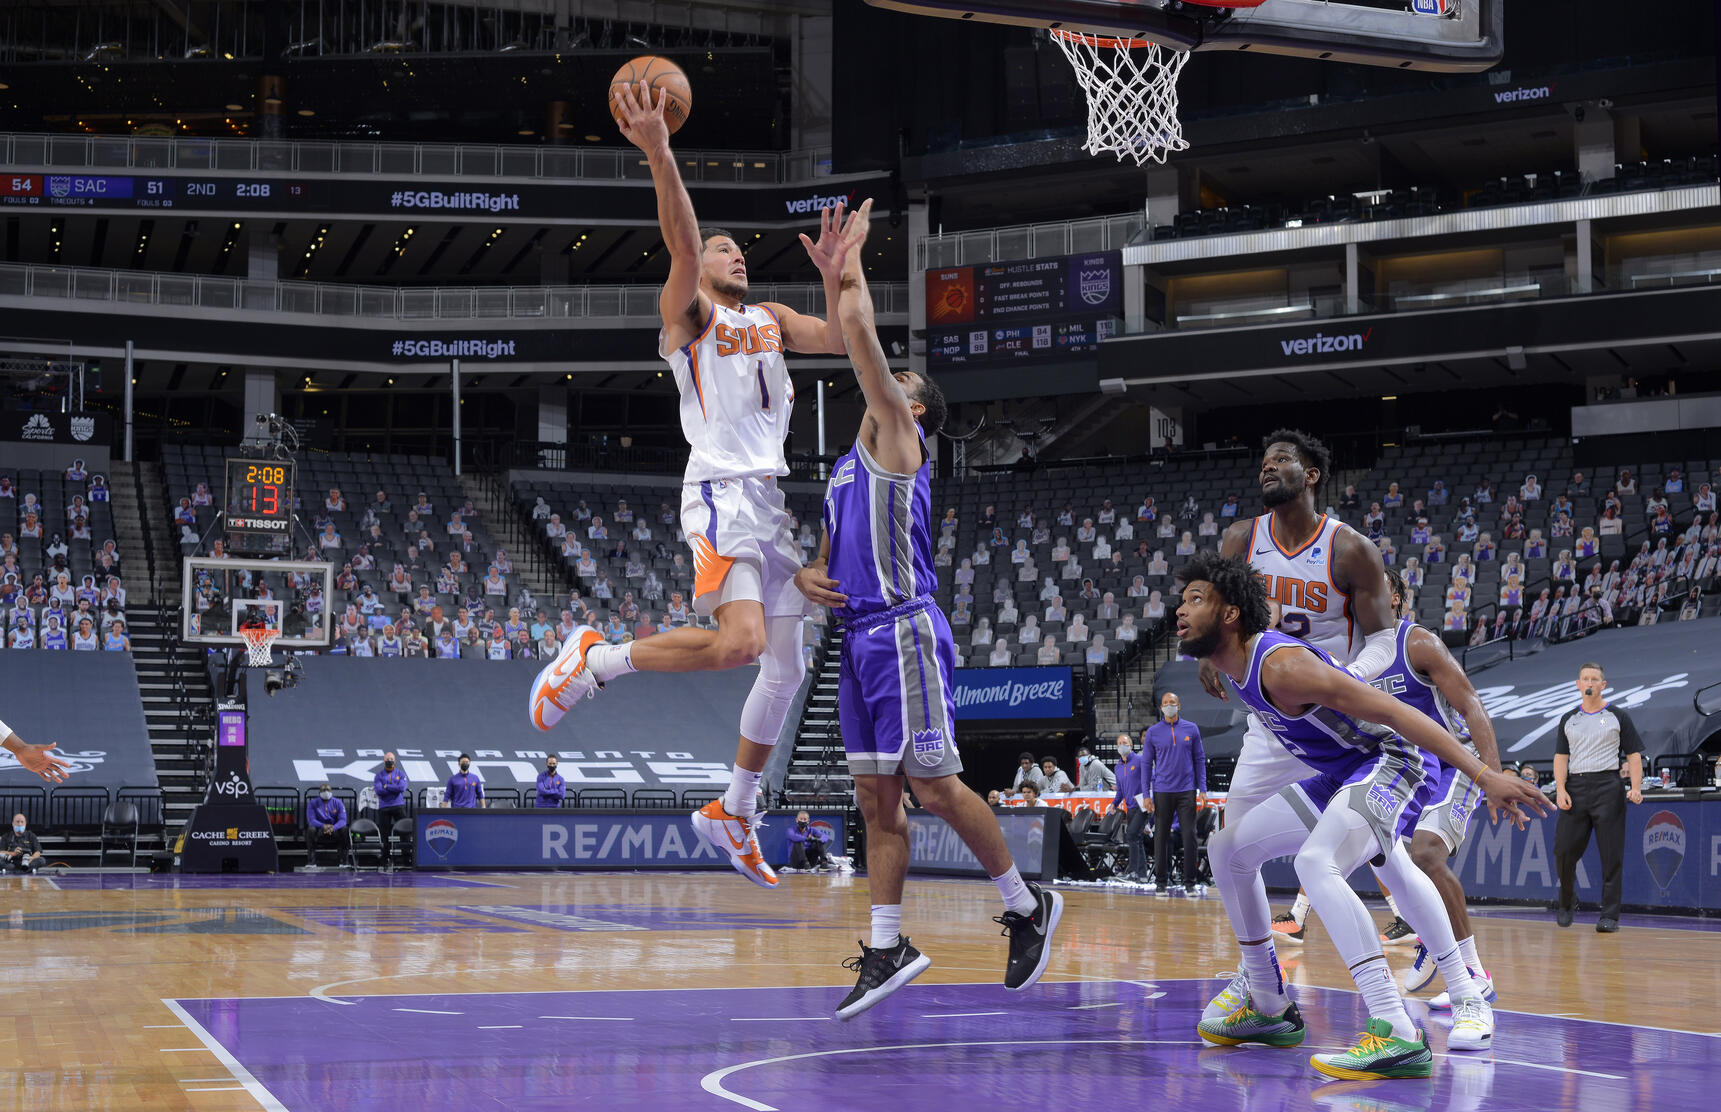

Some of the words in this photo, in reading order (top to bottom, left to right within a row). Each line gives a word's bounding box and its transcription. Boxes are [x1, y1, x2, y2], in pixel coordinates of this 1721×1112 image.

[1417, 0, 1434, 10] NBA
[1494, 86, 1550, 103] verizon
[12, 179, 32, 191] 54
[74, 180, 107, 192] SAC
[147, 181, 164, 194] 51
[187, 183, 216, 195] 2ND
[236, 184, 270, 197] 2:08
[291, 187, 301, 195] 13
[391, 191, 519, 212] #5GBuiltRight
[785, 194, 849, 214] verizon
[1008, 264, 1034, 274] HUSTLE
[1035, 262, 1059, 271] STATS
[1069, 324, 1083, 333] MIL
[943, 335, 959, 344] SAS
[1006, 331, 1020, 339] PHI
[1069, 335, 1086, 343] NYK
[392, 340, 516, 358] #5GBuiltRight
[943, 346, 961, 355] NOP
[1006, 340, 1022, 350] CLE
[1281, 333, 1363, 356] verizon
[757, 360, 770, 410] 1
[1157, 418, 1176, 438] 103
[247, 466, 284, 484] 2:08
[252, 485, 278, 514] 13
[245, 519, 288, 529] TISSOT
[953, 680, 1012, 708] Almond
[1009, 680, 1064, 707] Breeze
[218, 703, 245, 711] SPALDING
[914, 740, 944, 753] SAC
[315, 748, 694, 760] SACRAMENTO
[293, 759, 736, 784] KINGS
[1368, 790, 1393, 816] SAC
[191, 831, 225, 840] CACHE
[238, 831, 270, 839] CREEK
[429, 828, 455, 836] RE/MAX
[1648, 830, 1681, 846] RE/MAX
[541, 824, 719, 859] RE/MAX
